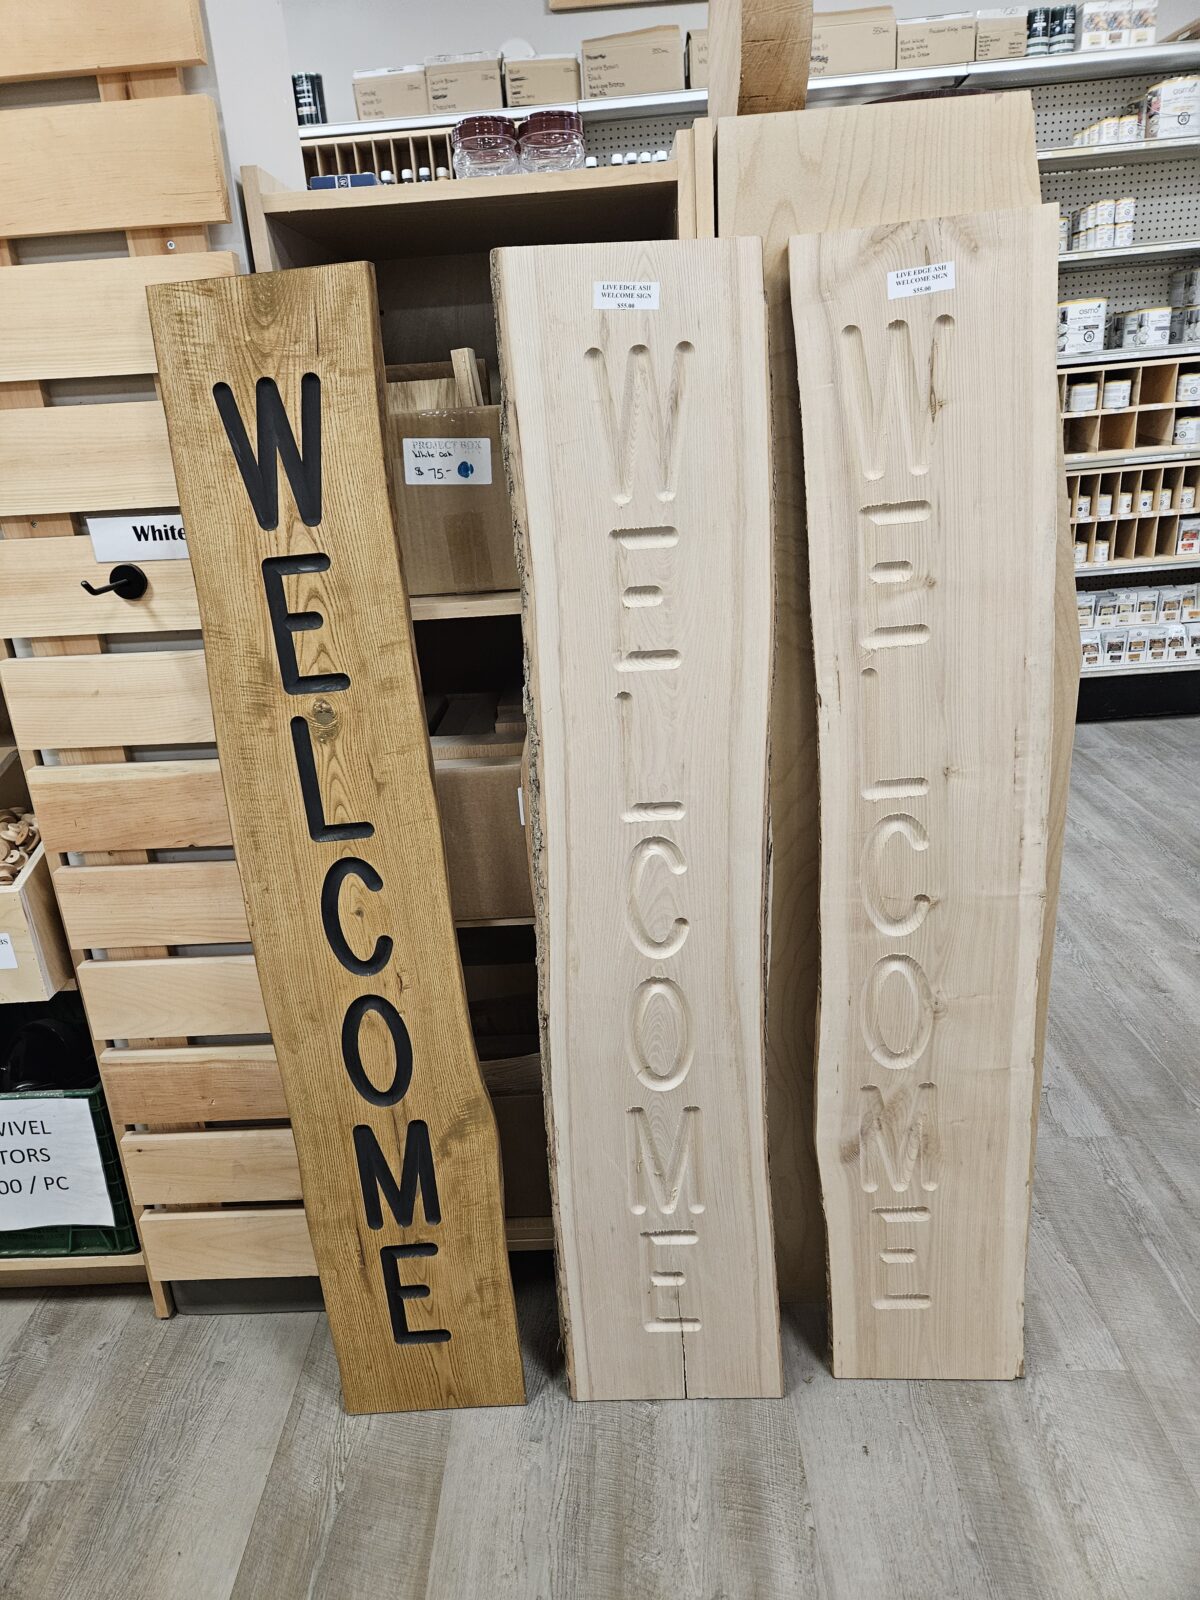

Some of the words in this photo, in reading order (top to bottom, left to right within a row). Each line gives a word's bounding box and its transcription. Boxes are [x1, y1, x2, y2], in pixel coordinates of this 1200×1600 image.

[896, 270, 912, 279] LIVE
[913, 267, 932, 275] EDGE
[933, 264, 947, 272] ASH
[895, 276, 931, 286] WELCOME
[931, 272, 949, 281] SIGN
[912, 286, 932, 294] $55.00
[412, 440, 457, 450] PROJECT
[460, 440, 482, 449] BOX
[412, 450, 435, 458] White
[132, 524, 187, 542] White
[841, 313, 956, 1310] WELCOME
[584, 340, 704, 1333] WELCOME
[212, 371, 452, 1345] WELCOME
[44, 1176, 70, 1190] PC
